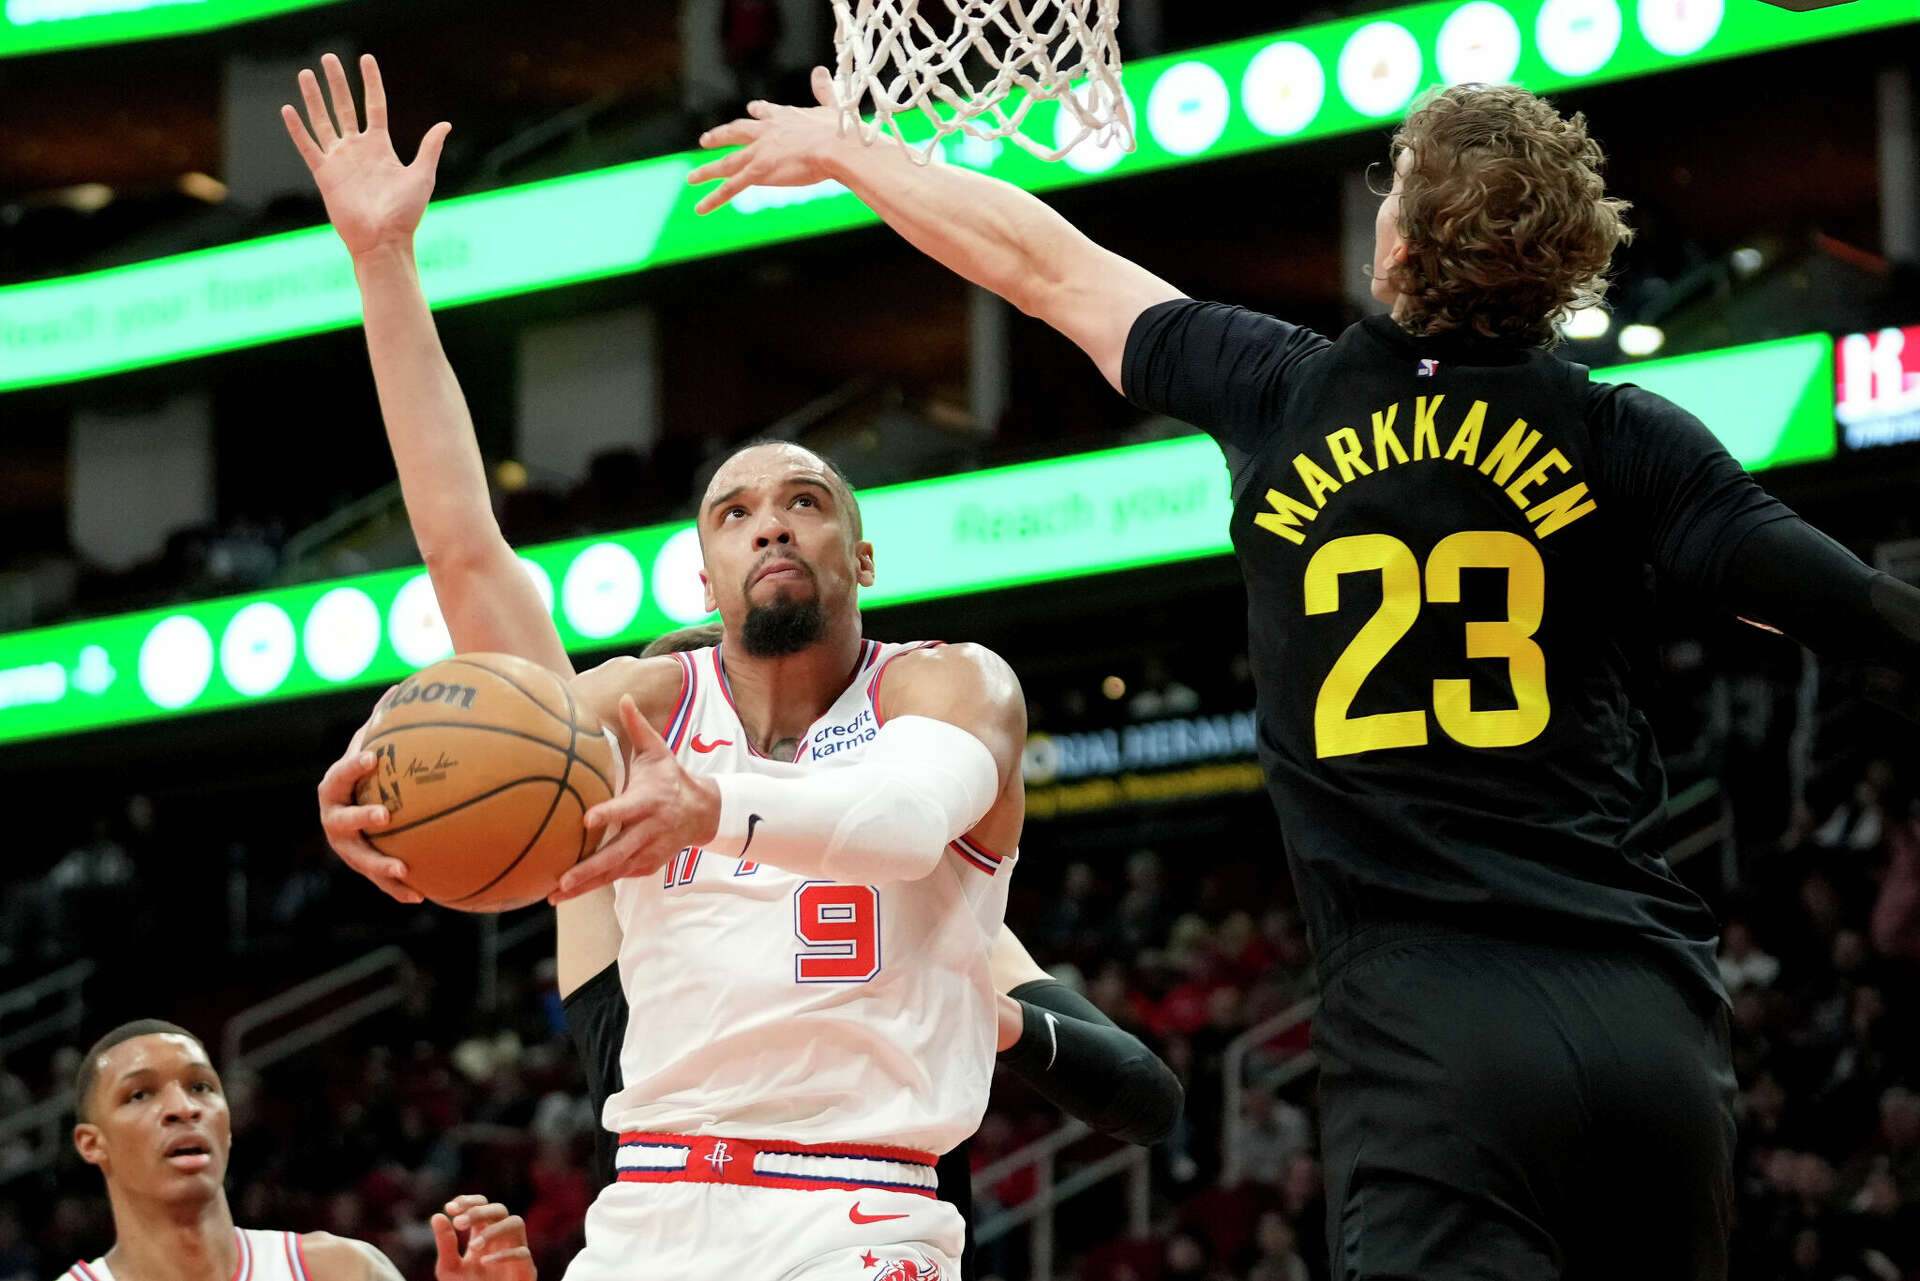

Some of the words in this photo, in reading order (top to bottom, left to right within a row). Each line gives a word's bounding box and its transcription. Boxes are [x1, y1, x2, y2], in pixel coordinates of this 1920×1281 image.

[954, 494, 1096, 545] Reach
[1109, 475, 1209, 536] your
[1254, 394, 1598, 545] MARKKANEN
[1304, 531, 1551, 759] 23
[812, 727, 877, 761] karma
[815, 710, 872, 743] credit
[794, 880, 881, 983] 9
